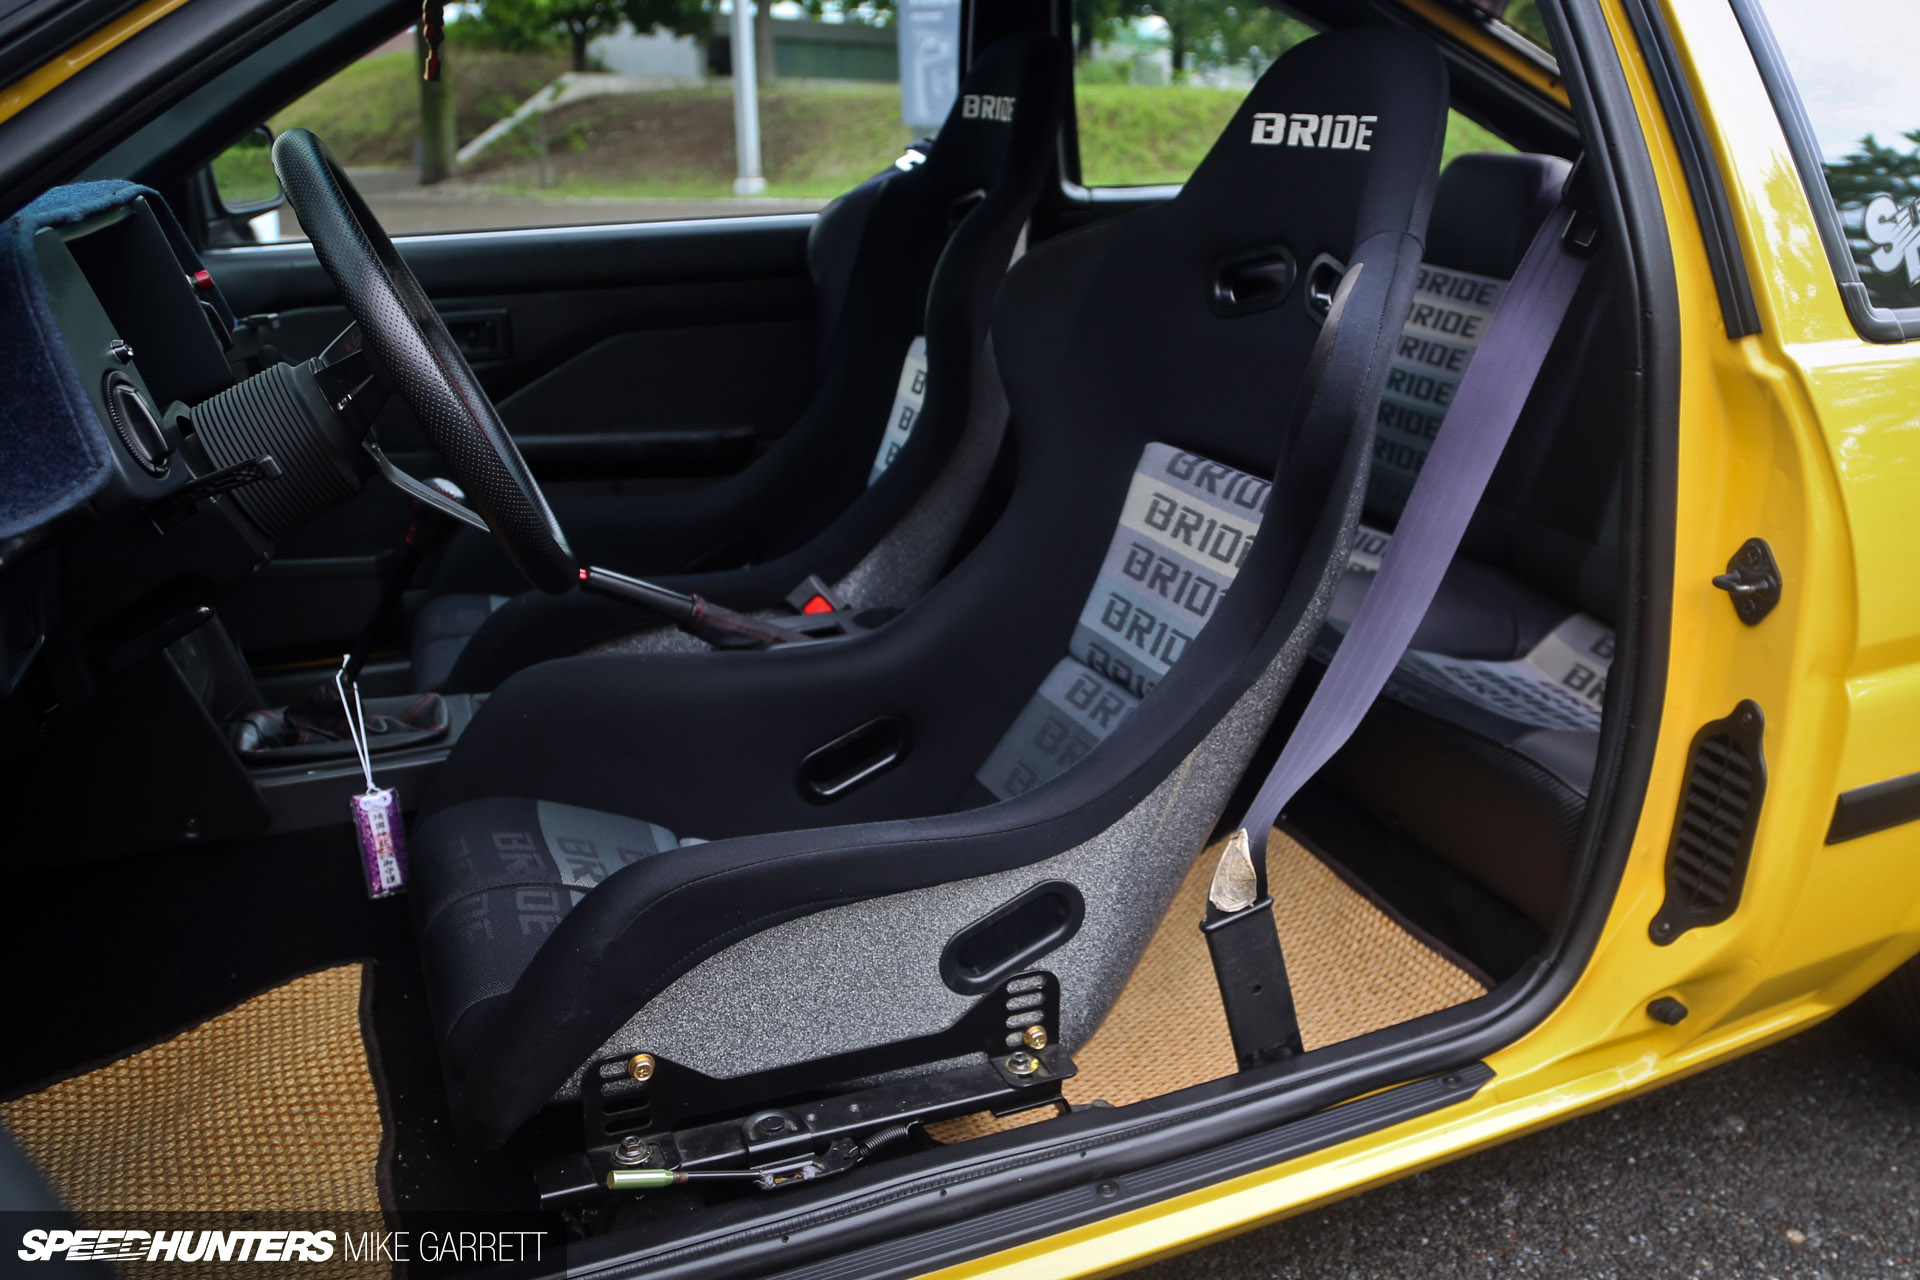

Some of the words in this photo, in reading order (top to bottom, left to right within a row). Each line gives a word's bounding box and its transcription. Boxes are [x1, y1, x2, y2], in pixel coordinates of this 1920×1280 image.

[961, 94, 1016, 121] BRIDE
[1250, 112, 1378, 151] BRIDE
[1398, 335, 1467, 372] RIDE
[1387, 367, 1453, 406] RIDE
[1378, 401, 1443, 440] RIDE
[1165, 451, 1273, 515] BRID
[1122, 541, 1229, 618] BRID
[1101, 592, 1196, 667] BRID
